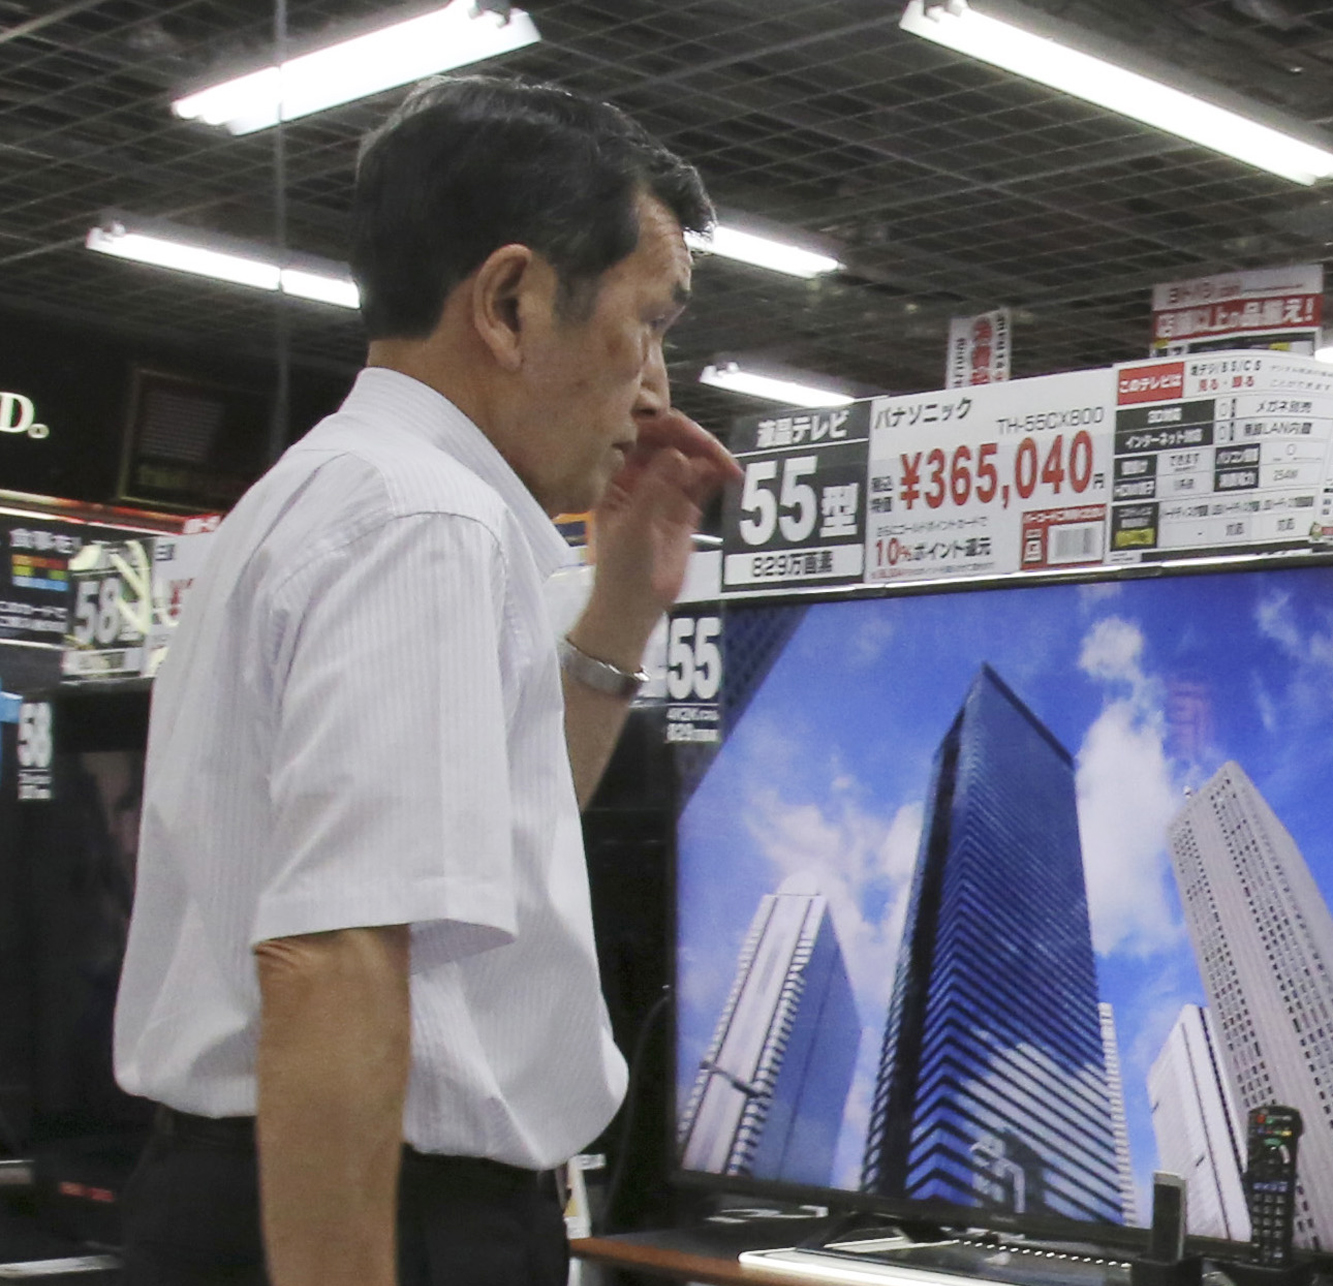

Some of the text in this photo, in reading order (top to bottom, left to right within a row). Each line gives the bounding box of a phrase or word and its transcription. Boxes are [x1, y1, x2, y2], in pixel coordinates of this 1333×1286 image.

[875, 397, 972, 429] パナソニック
[667, 617, 722, 699] 55
